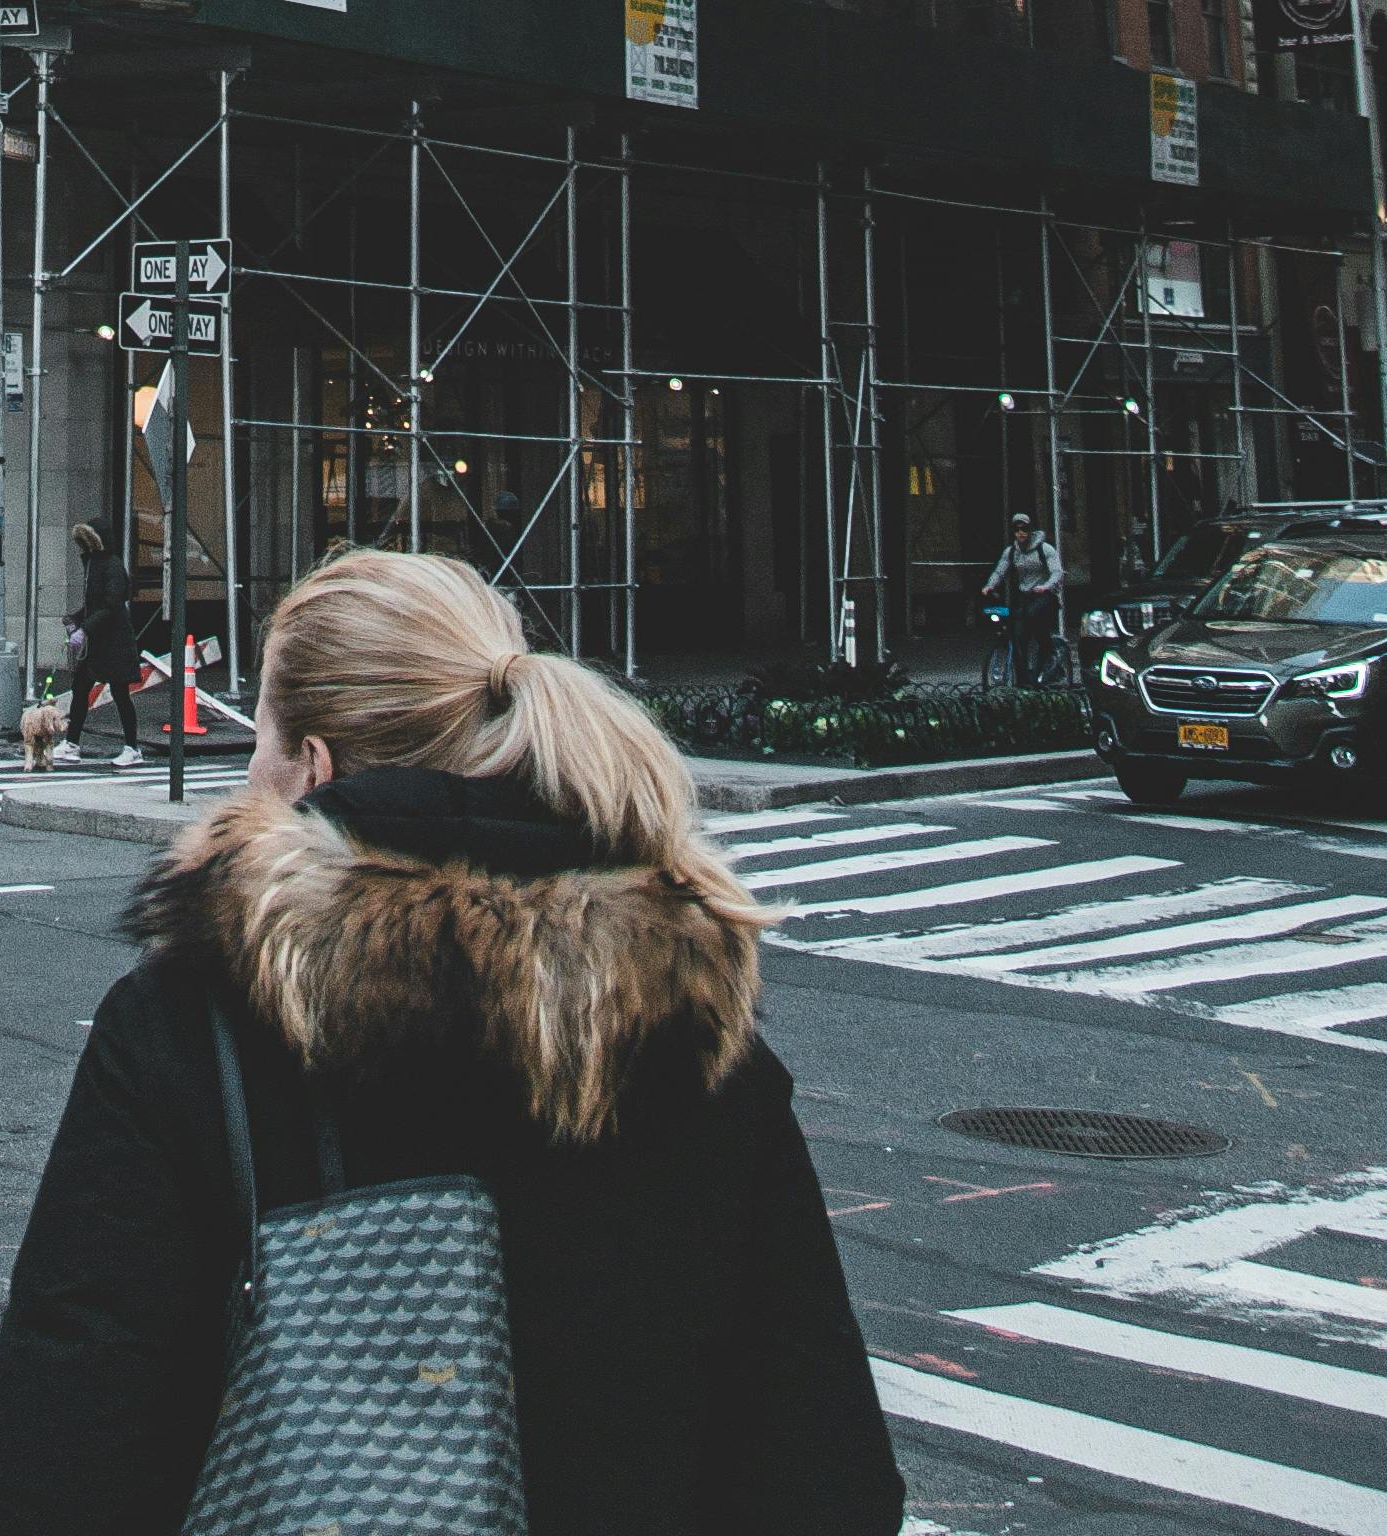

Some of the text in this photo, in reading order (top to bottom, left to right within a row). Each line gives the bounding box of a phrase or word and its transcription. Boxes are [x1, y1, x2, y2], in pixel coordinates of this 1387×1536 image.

[0, 9, 21, 24] AY
[144, 258, 209, 280] ONE AY
